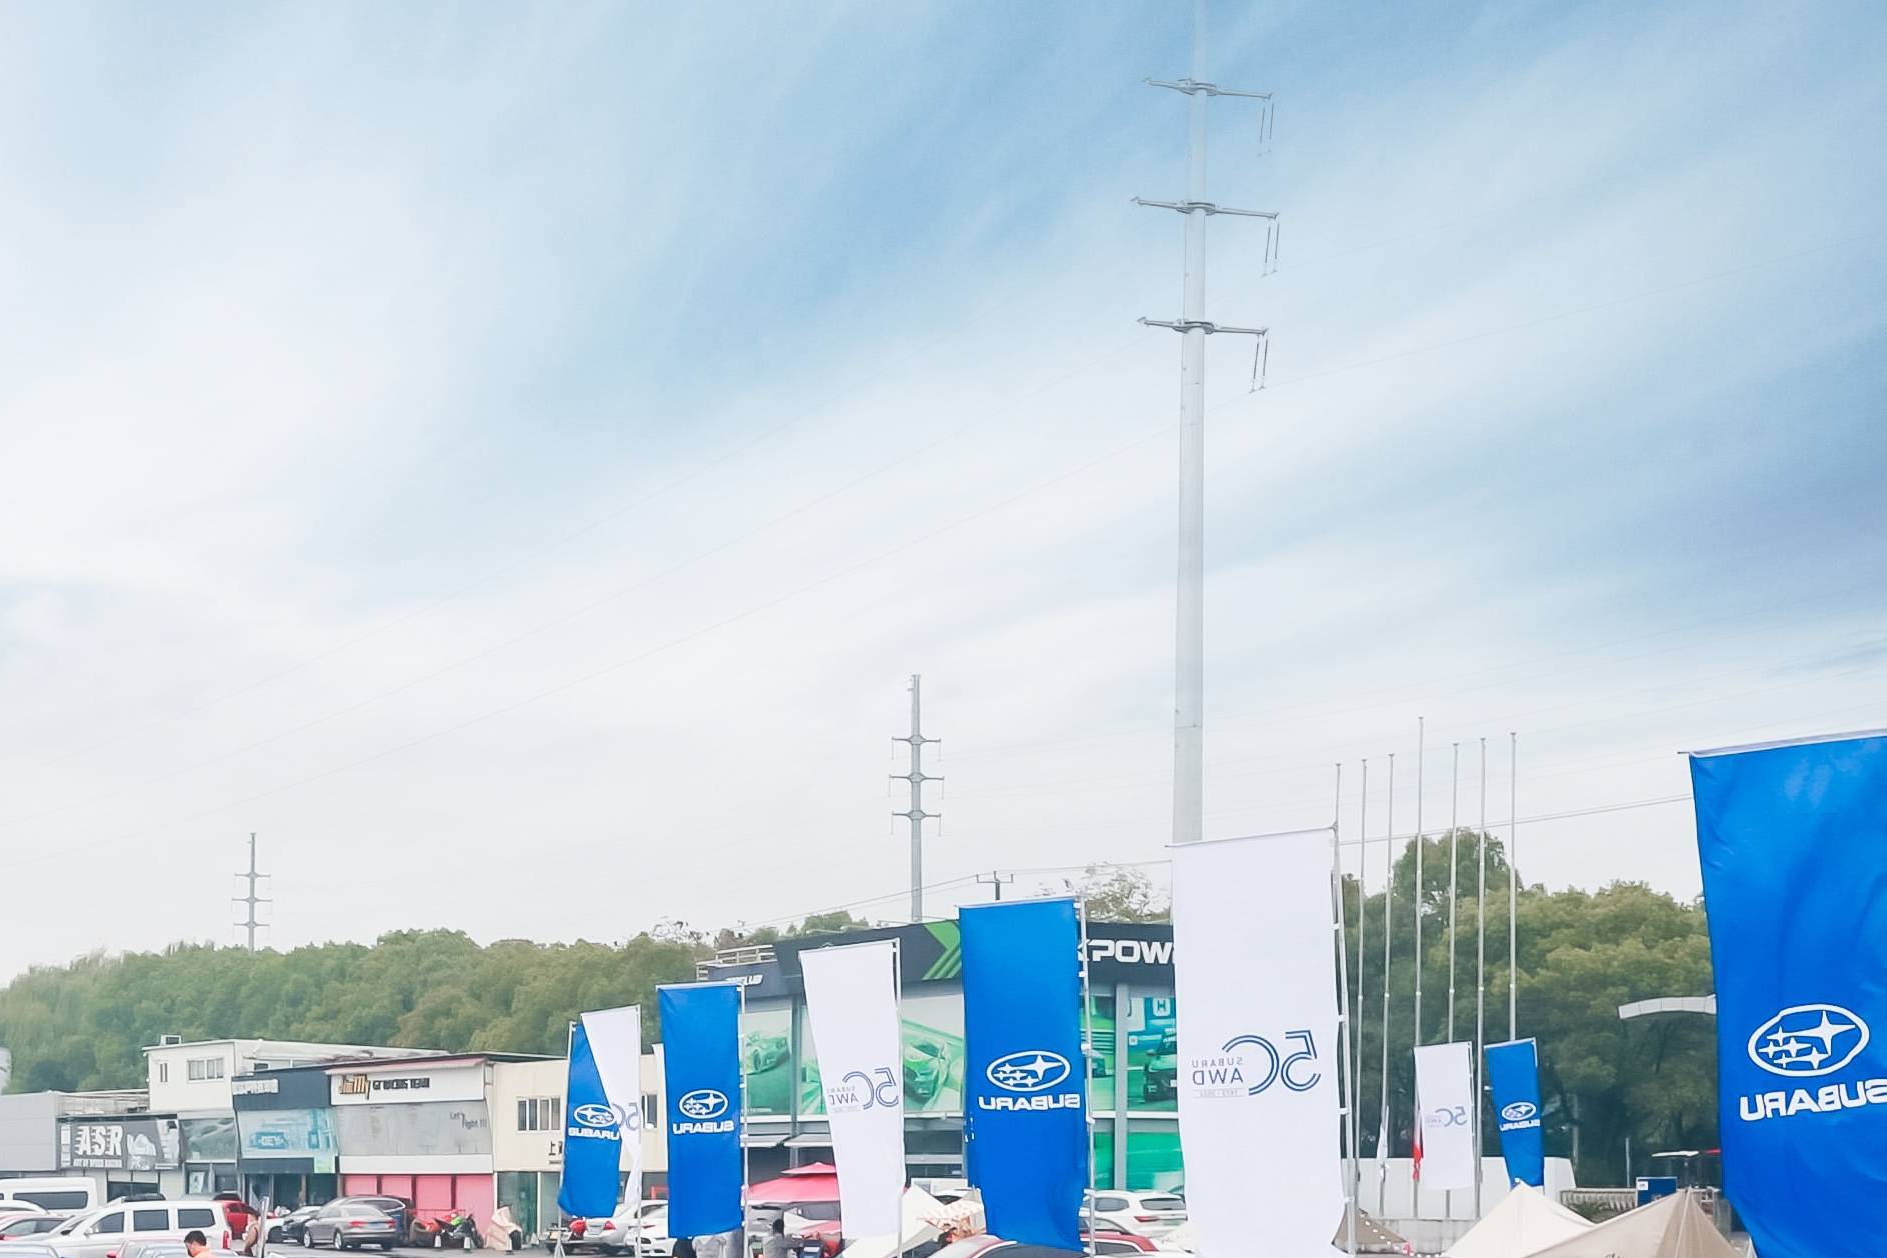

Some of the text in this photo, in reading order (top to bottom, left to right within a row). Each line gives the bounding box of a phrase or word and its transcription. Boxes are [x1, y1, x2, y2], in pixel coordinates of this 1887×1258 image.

[1078, 940, 1175, 964] POW
[74, 1125, 123, 1156] ASR
[568, 1126, 620, 1141] SUBARU
